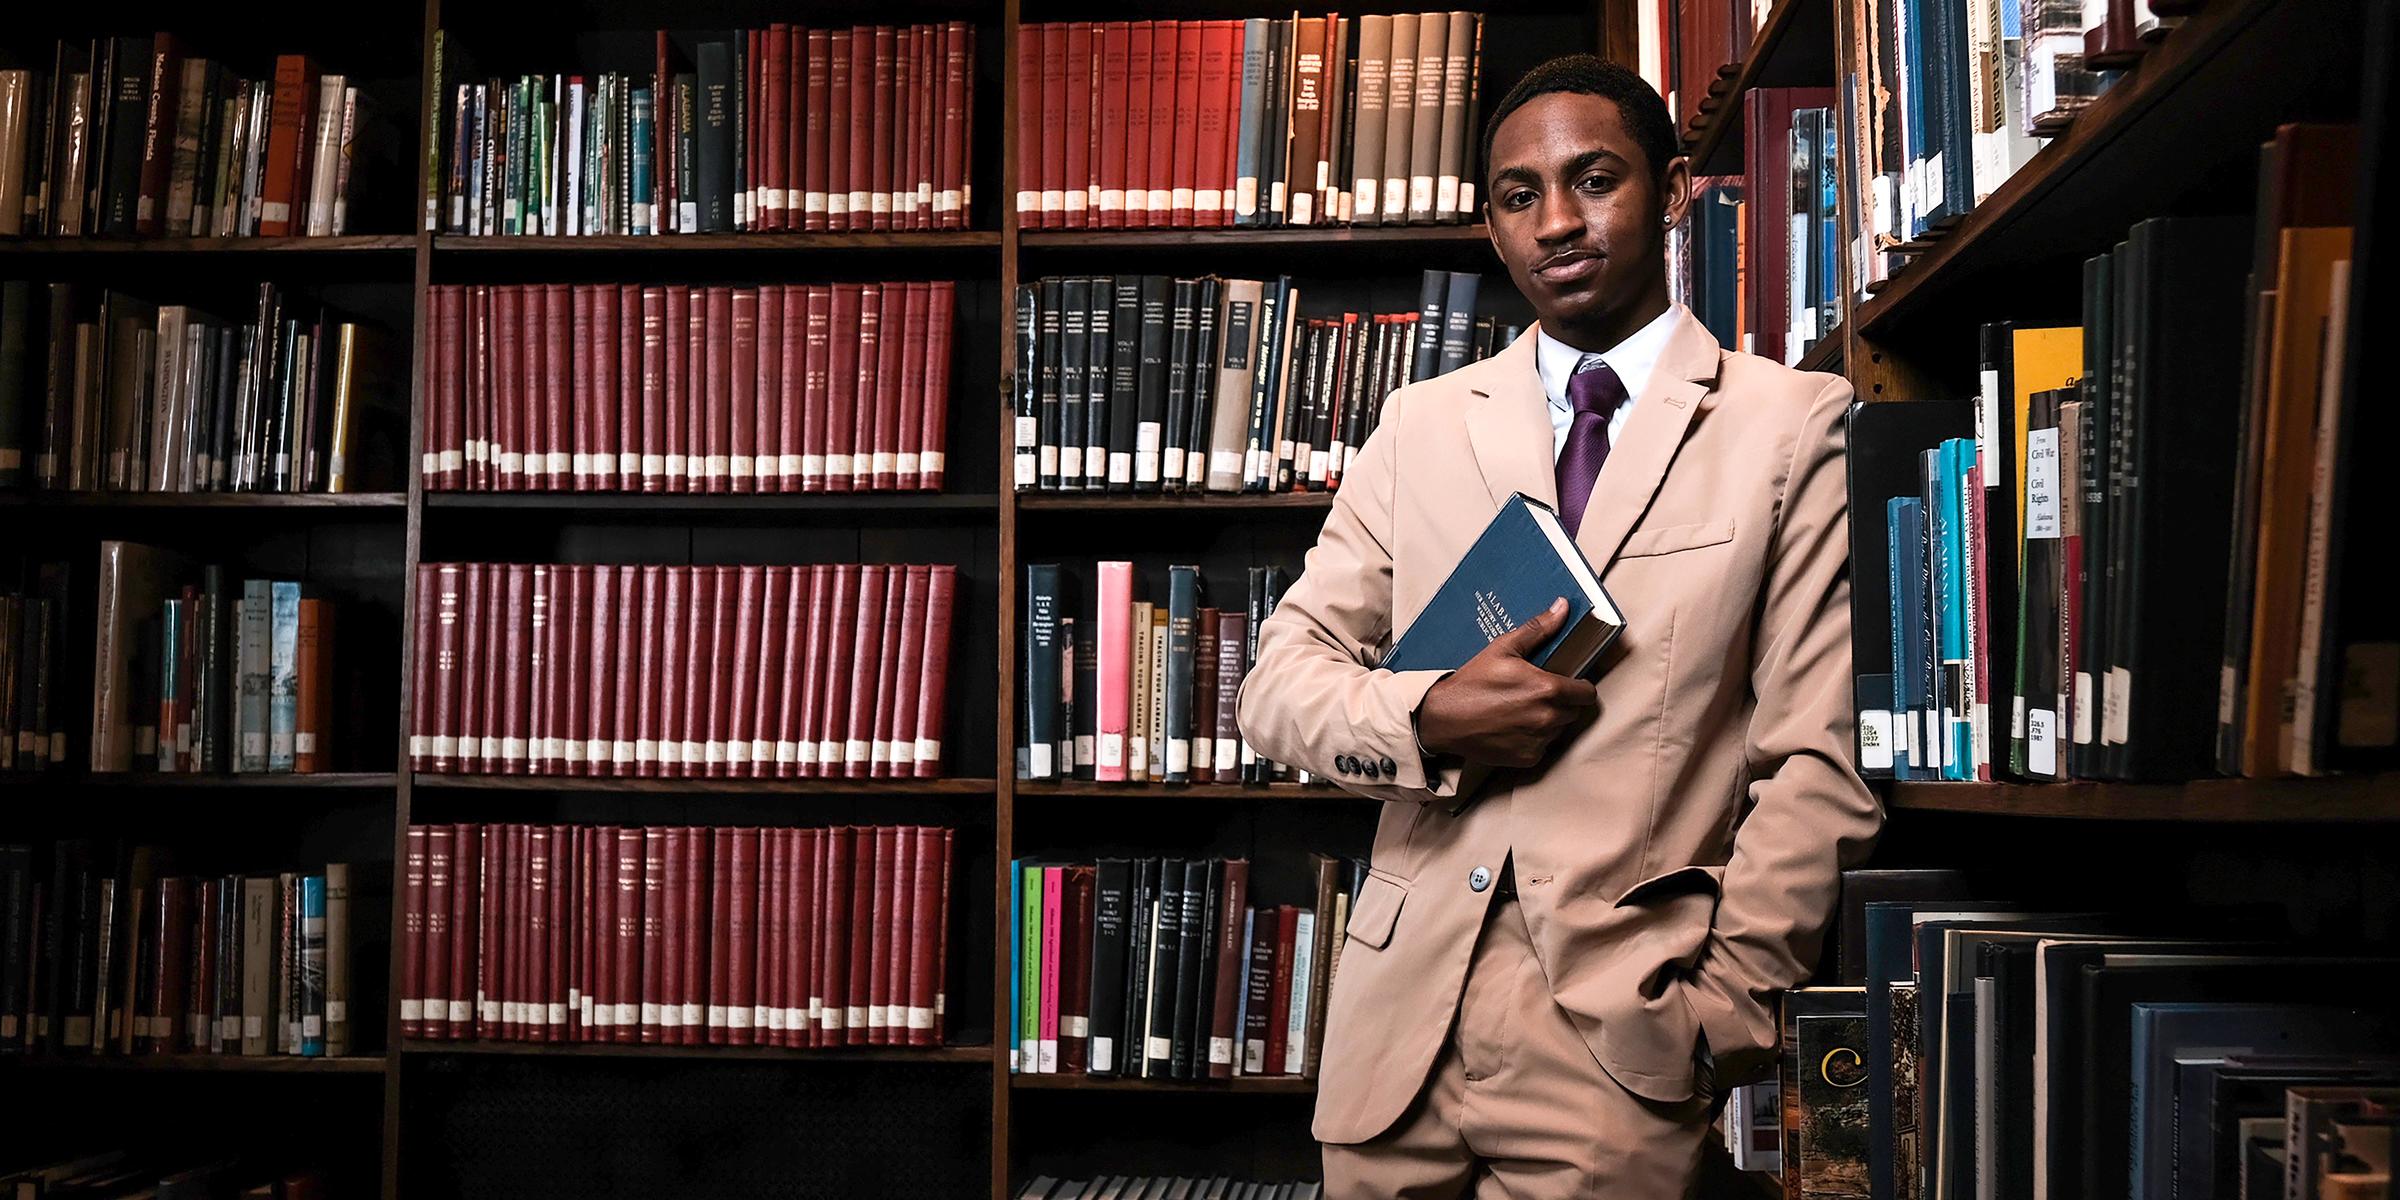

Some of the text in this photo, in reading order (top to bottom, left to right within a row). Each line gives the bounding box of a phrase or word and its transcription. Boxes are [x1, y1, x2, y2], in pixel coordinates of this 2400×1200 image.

[681, 84, 691, 134] ALABAMA
[485, 139, 495, 208] CURIOSITIES
[2031, 449, 2044, 460] Civil
[2031, 479, 2044, 489] Civil
[2031, 493, 2049, 506] Rights
